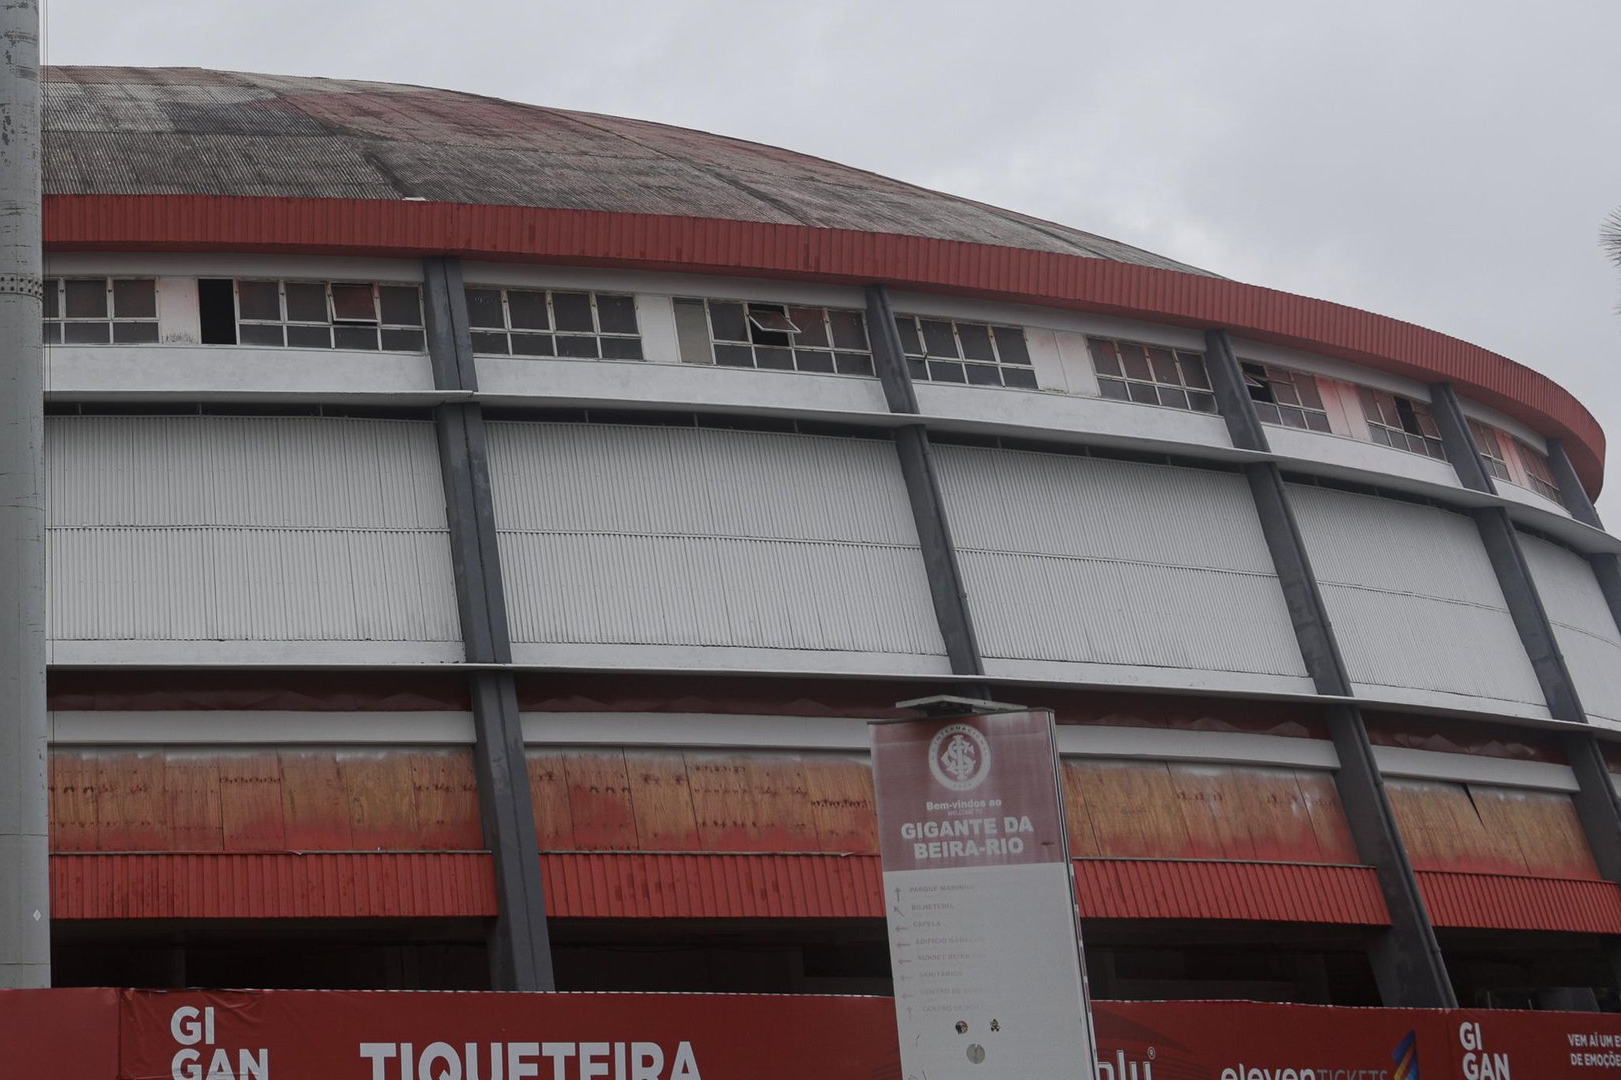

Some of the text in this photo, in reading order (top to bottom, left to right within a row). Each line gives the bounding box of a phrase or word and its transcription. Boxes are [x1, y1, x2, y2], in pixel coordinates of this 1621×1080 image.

[926, 798, 1002, 811] Bem-vindos ao
[900, 816, 1034, 840] GIGANTE DA
[914, 837, 1024, 860] BEIRA-RIO
[170, 1005, 215, 1045] GI
[1459, 1021, 1482, 1051] GI
[1567, 1033, 1588, 1047] VEM
[1589, 1031, 1599, 1047] AÍ
[1600, 1033, 1613, 1048] UM
[170, 1048, 268, 1080] GAN
[359, 1041, 703, 1080] TIQUETEIRA
[1462, 1052, 1511, 1080] GAN
[1570, 1052, 1583, 1066] DE
